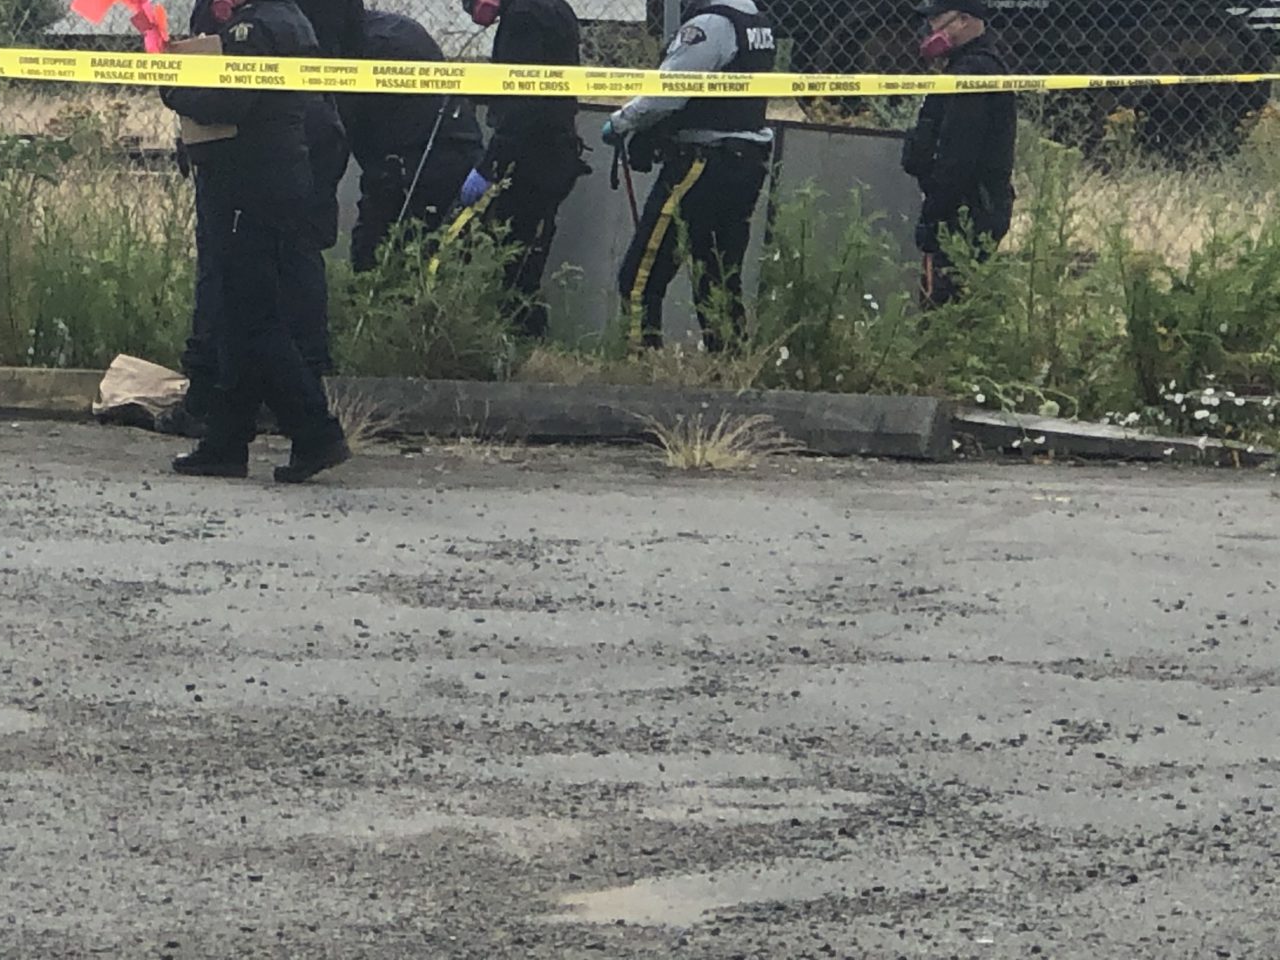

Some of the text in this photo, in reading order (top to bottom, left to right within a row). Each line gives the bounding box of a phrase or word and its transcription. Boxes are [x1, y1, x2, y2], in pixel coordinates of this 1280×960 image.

[42, 57, 77, 66] STOPPERS
[90, 57, 183, 70] BARRAGE DE POLICE
[225, 62, 280, 73] POLICE LINE
[300, 64, 359, 74] CRIME STOPPERS
[372, 66, 465, 77] BARRAGE DE POLICE
[94, 70, 179, 82] PASSAGE INTERDIT
[219, 74, 286, 85] DO NOT CROSS
[508, 69, 564, 79] POLICE LINE
[375, 78, 462, 90] PASSAGE INTERDIT
[502, 81, 570, 91] DO NOT CROSS
[662, 81, 750, 92] PASSAGE INTERDIT
[792, 81, 861, 91] DO NOT CROSS
[955, 79, 1047, 89] PASSAGE INTERDIT
